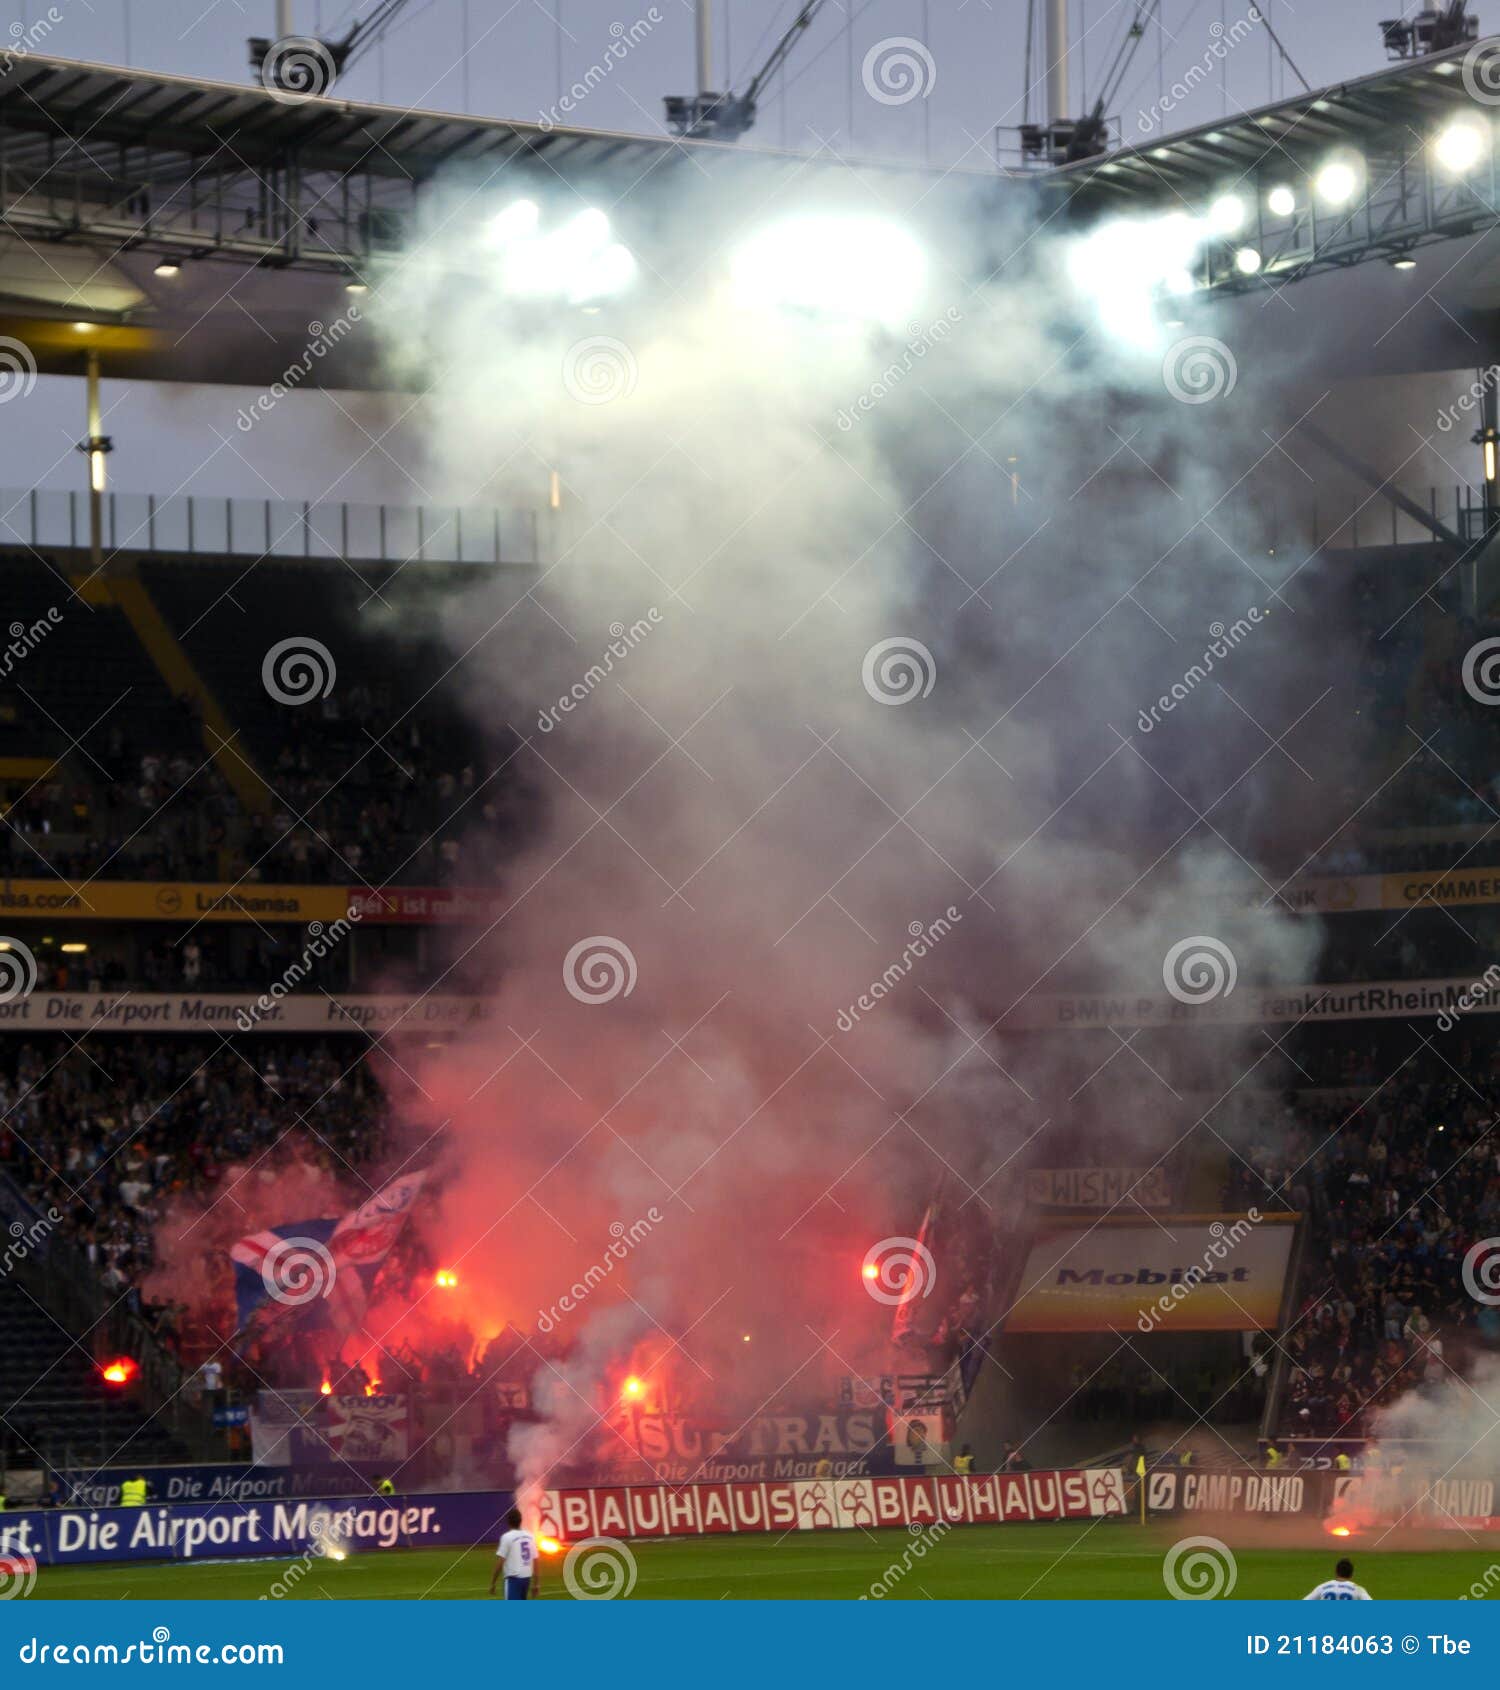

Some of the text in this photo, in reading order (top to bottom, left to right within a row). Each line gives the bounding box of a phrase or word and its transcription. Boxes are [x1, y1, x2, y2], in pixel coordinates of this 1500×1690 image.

[46, 999, 83, 1019] Die
[91, 1001, 170, 1024] Airport
[655, 1462, 688, 1482] Die
[696, 1461, 766, 1482] Airport
[773, 1457, 871, 1479] Manger.
[167, 1478, 201, 1498] Die
[210, 1475, 284, 1501] Airport
[876, 1477, 1088, 1519] BAUHAUS
[1183, 1474, 1304, 1512] CAMP DAVID
[564, 1489, 794, 1532] BAUHAUS
[58, 1514, 118, 1553] Die
[130, 1509, 261, 1557] Airport
[273, 1503, 441, 1547] Manager.
[520, 1541, 531, 1561] 5
